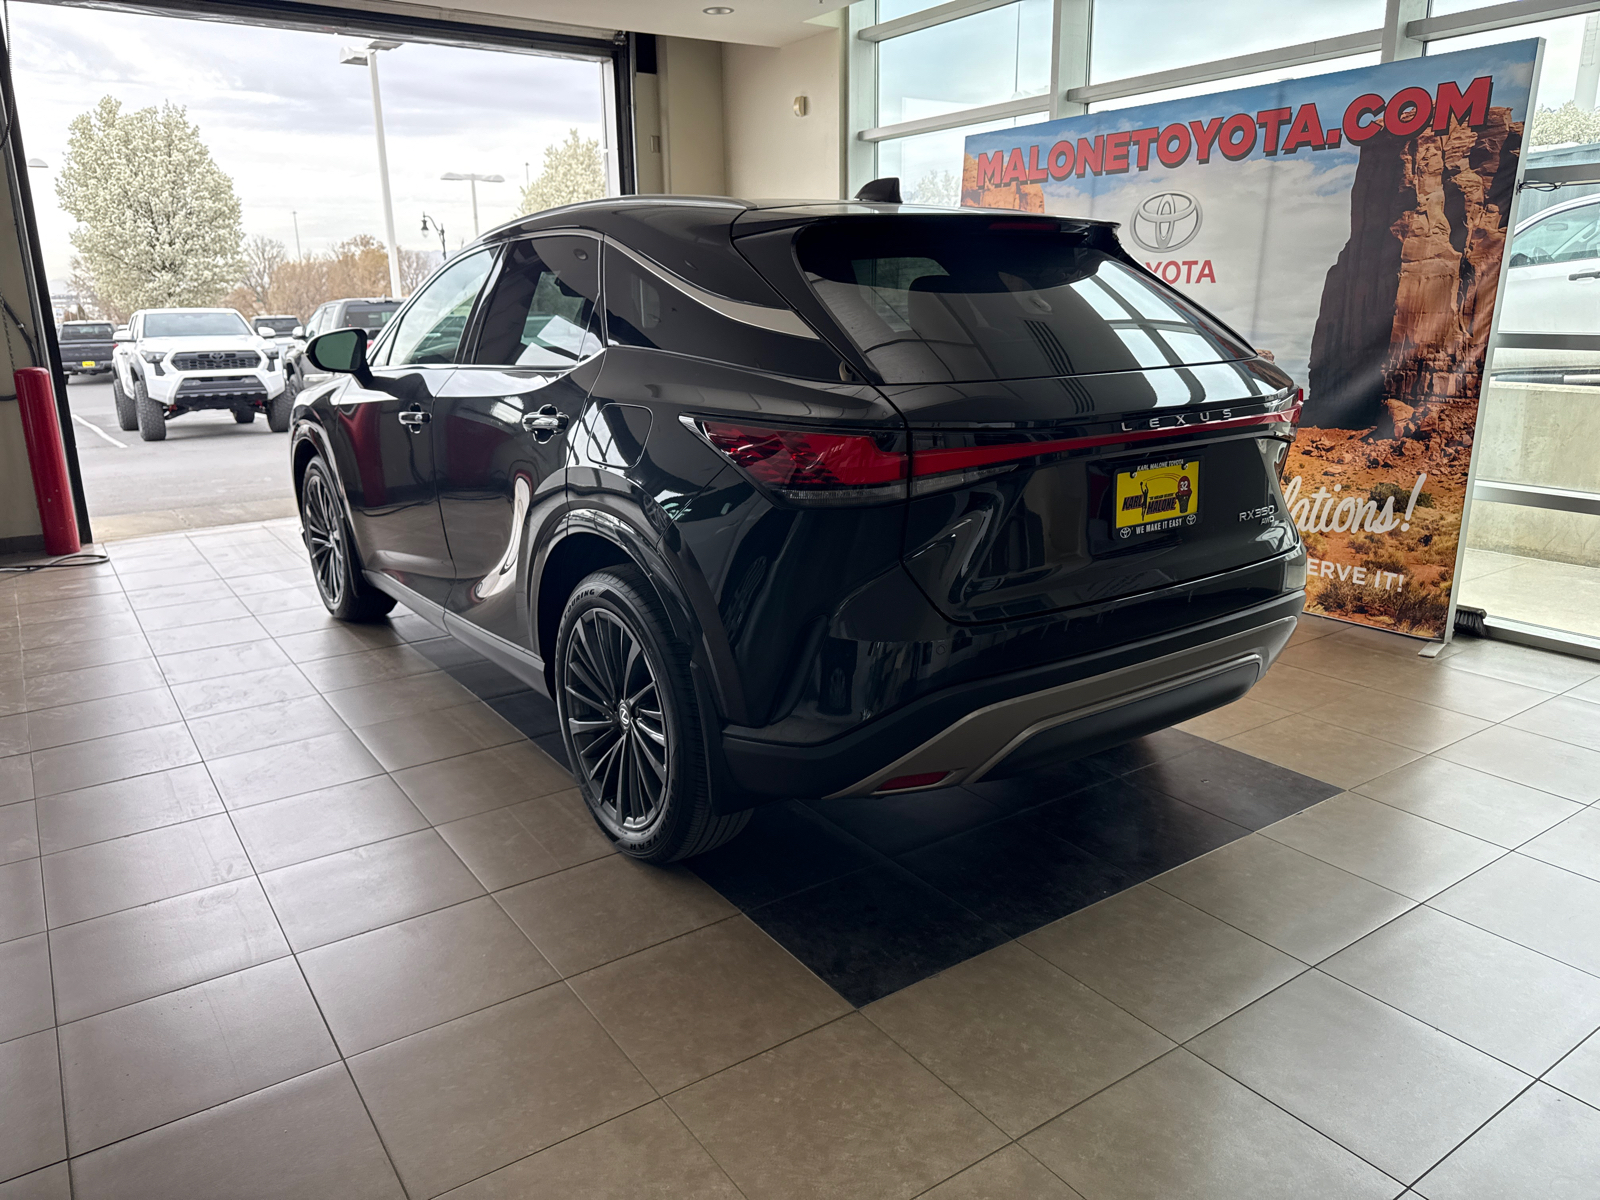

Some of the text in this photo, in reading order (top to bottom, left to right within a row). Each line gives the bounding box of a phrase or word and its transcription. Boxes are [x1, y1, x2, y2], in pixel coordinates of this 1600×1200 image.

[977, 75, 1493, 187] MALONETOYOTA.COM
[1121, 408, 1233, 431] LEXUS
[1180, 481, 1188, 491] 32
[1136, 518, 1182, 534] WE MAKE IT EASY
[1374, 569, 1404, 592] IT!
